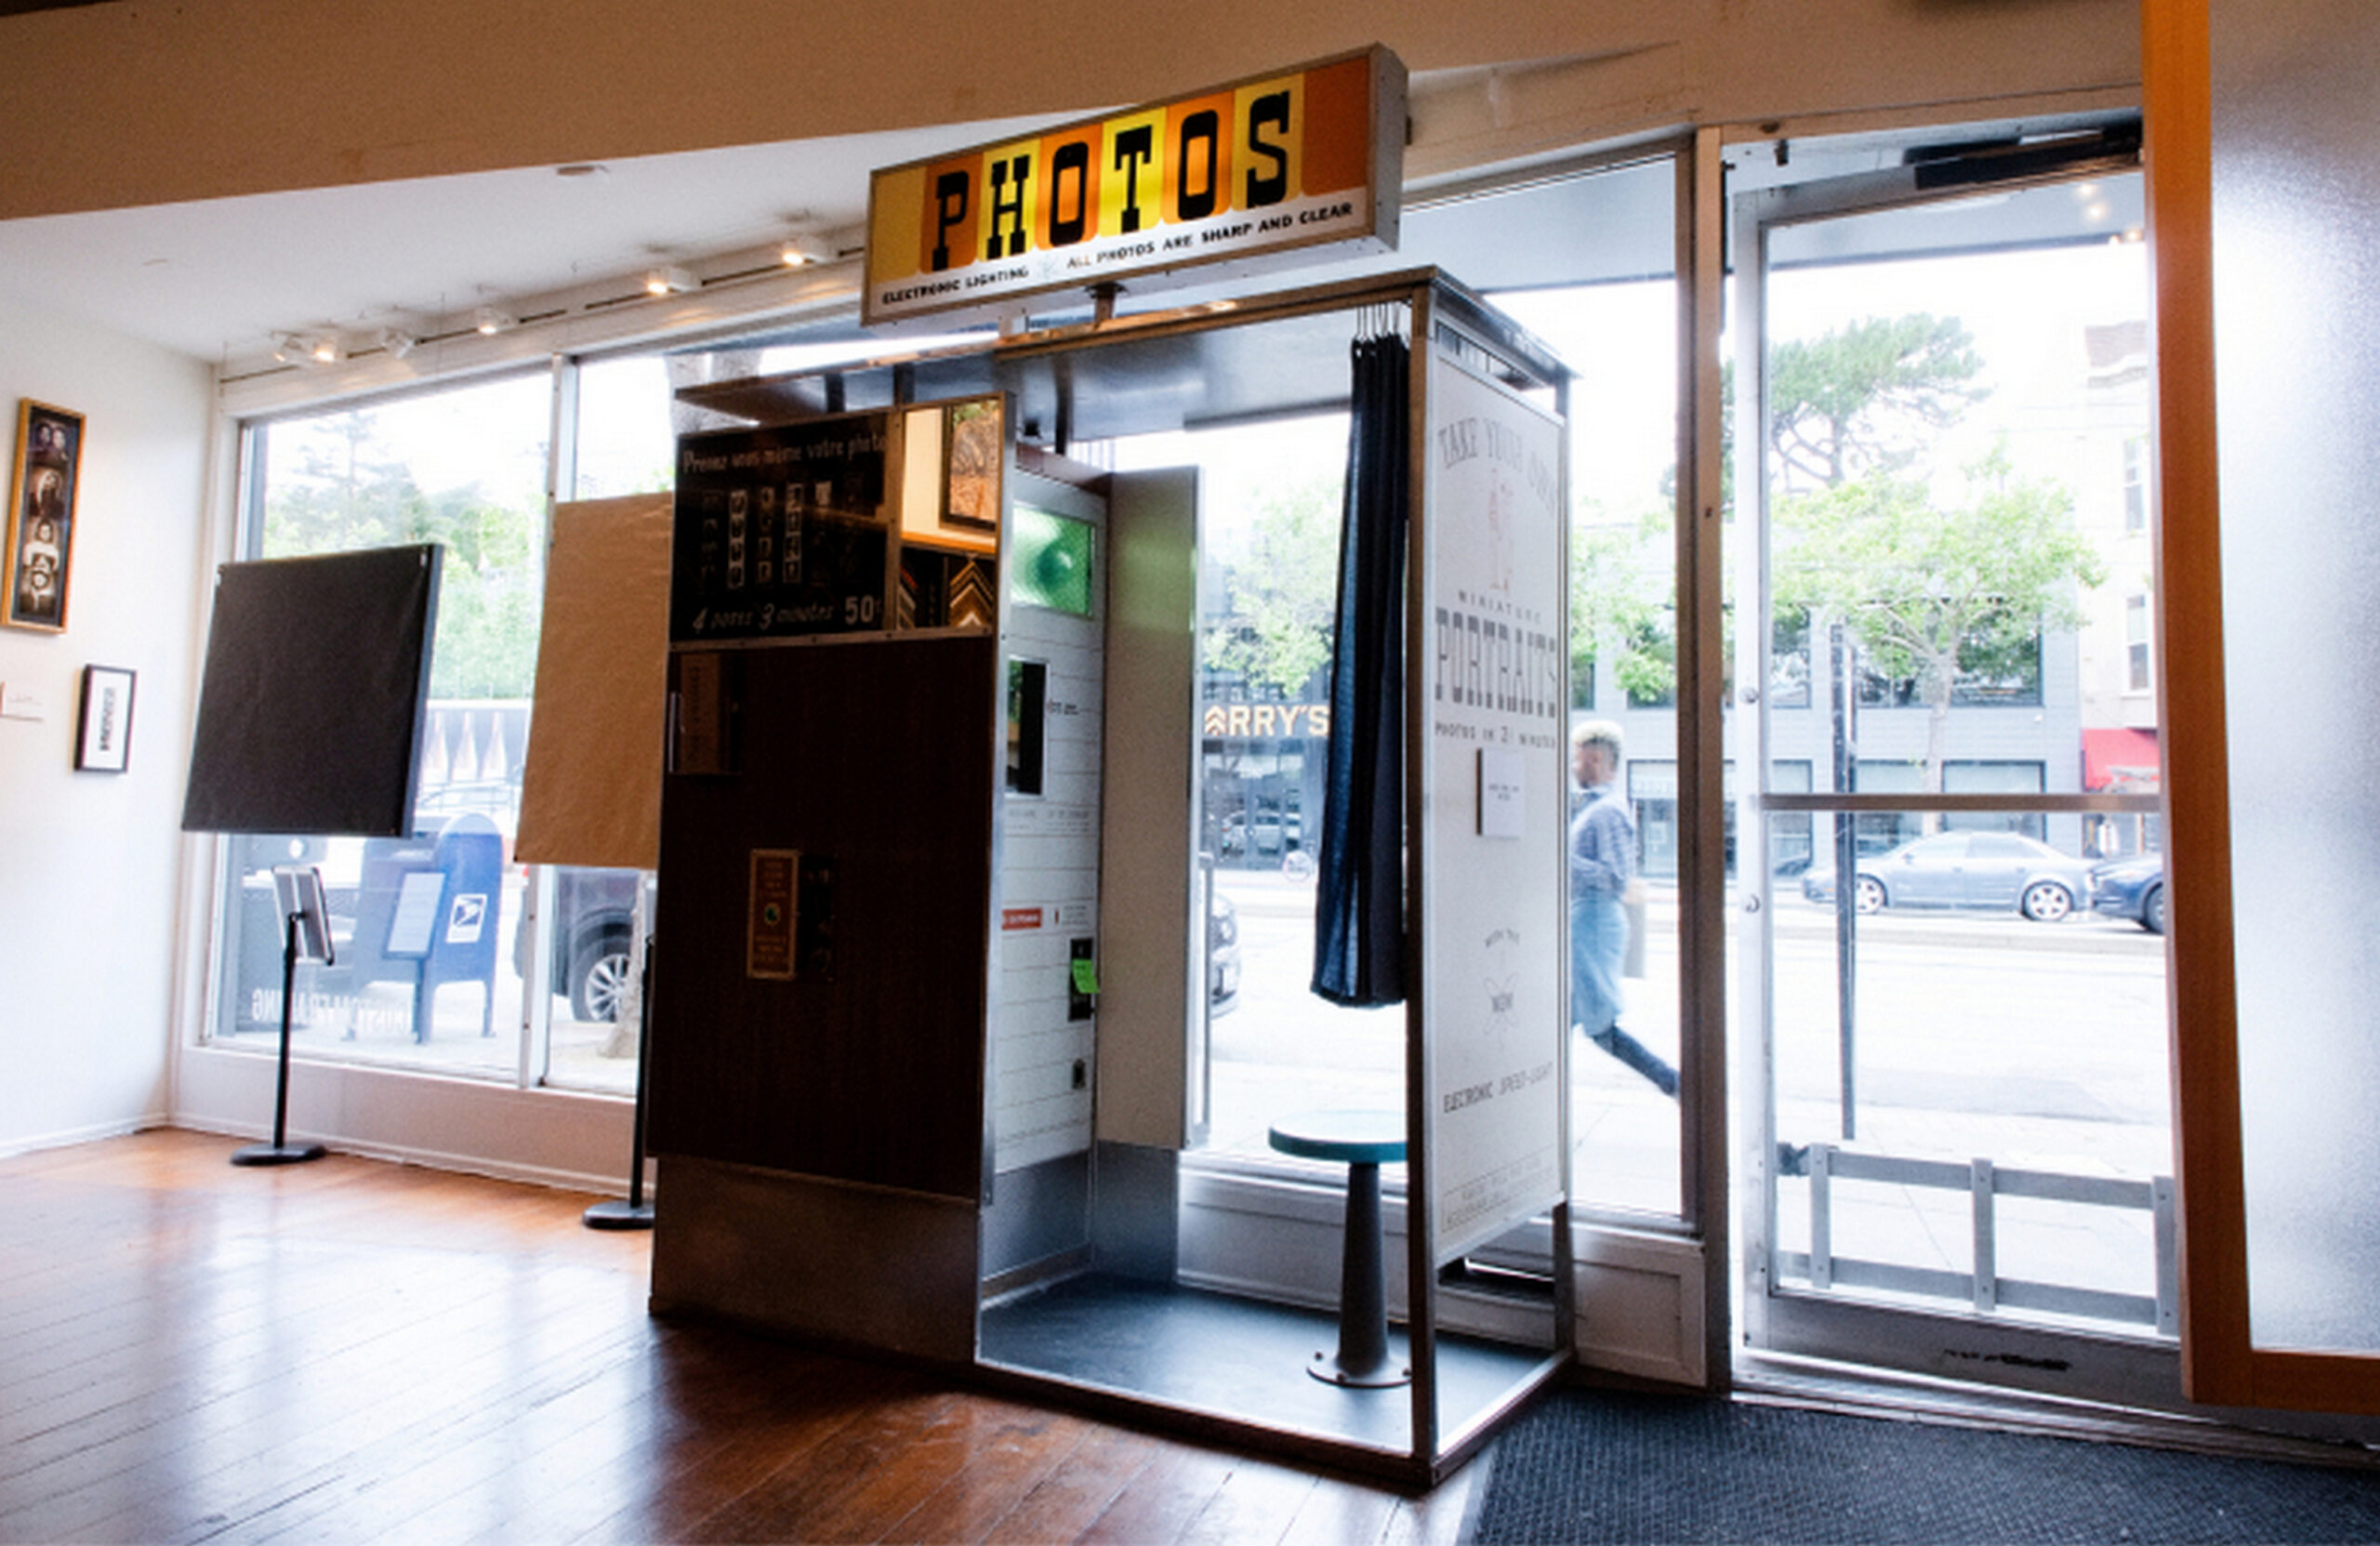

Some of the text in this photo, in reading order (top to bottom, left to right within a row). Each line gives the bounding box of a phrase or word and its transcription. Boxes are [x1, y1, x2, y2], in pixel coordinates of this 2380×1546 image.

[931, 89, 1290, 272] PHOTOS
[1067, 201, 1354, 270] ALL PHOTOS ARE SHARP AND CLEAR
[881, 265, 1029, 305] ELECTRONIC LIGHTING
[806, 437, 844, 459] votre
[1437, 416, 1478, 470] TAKE
[693, 608, 708, 636] 4
[710, 610, 754, 631] poses
[758, 602, 775, 631] 3
[1458, 589, 1541, 626] MINIATURE
[1435, 720, 1476, 741] PHOTOS
[1443, 1079, 1494, 1114] ELECTRONIC
